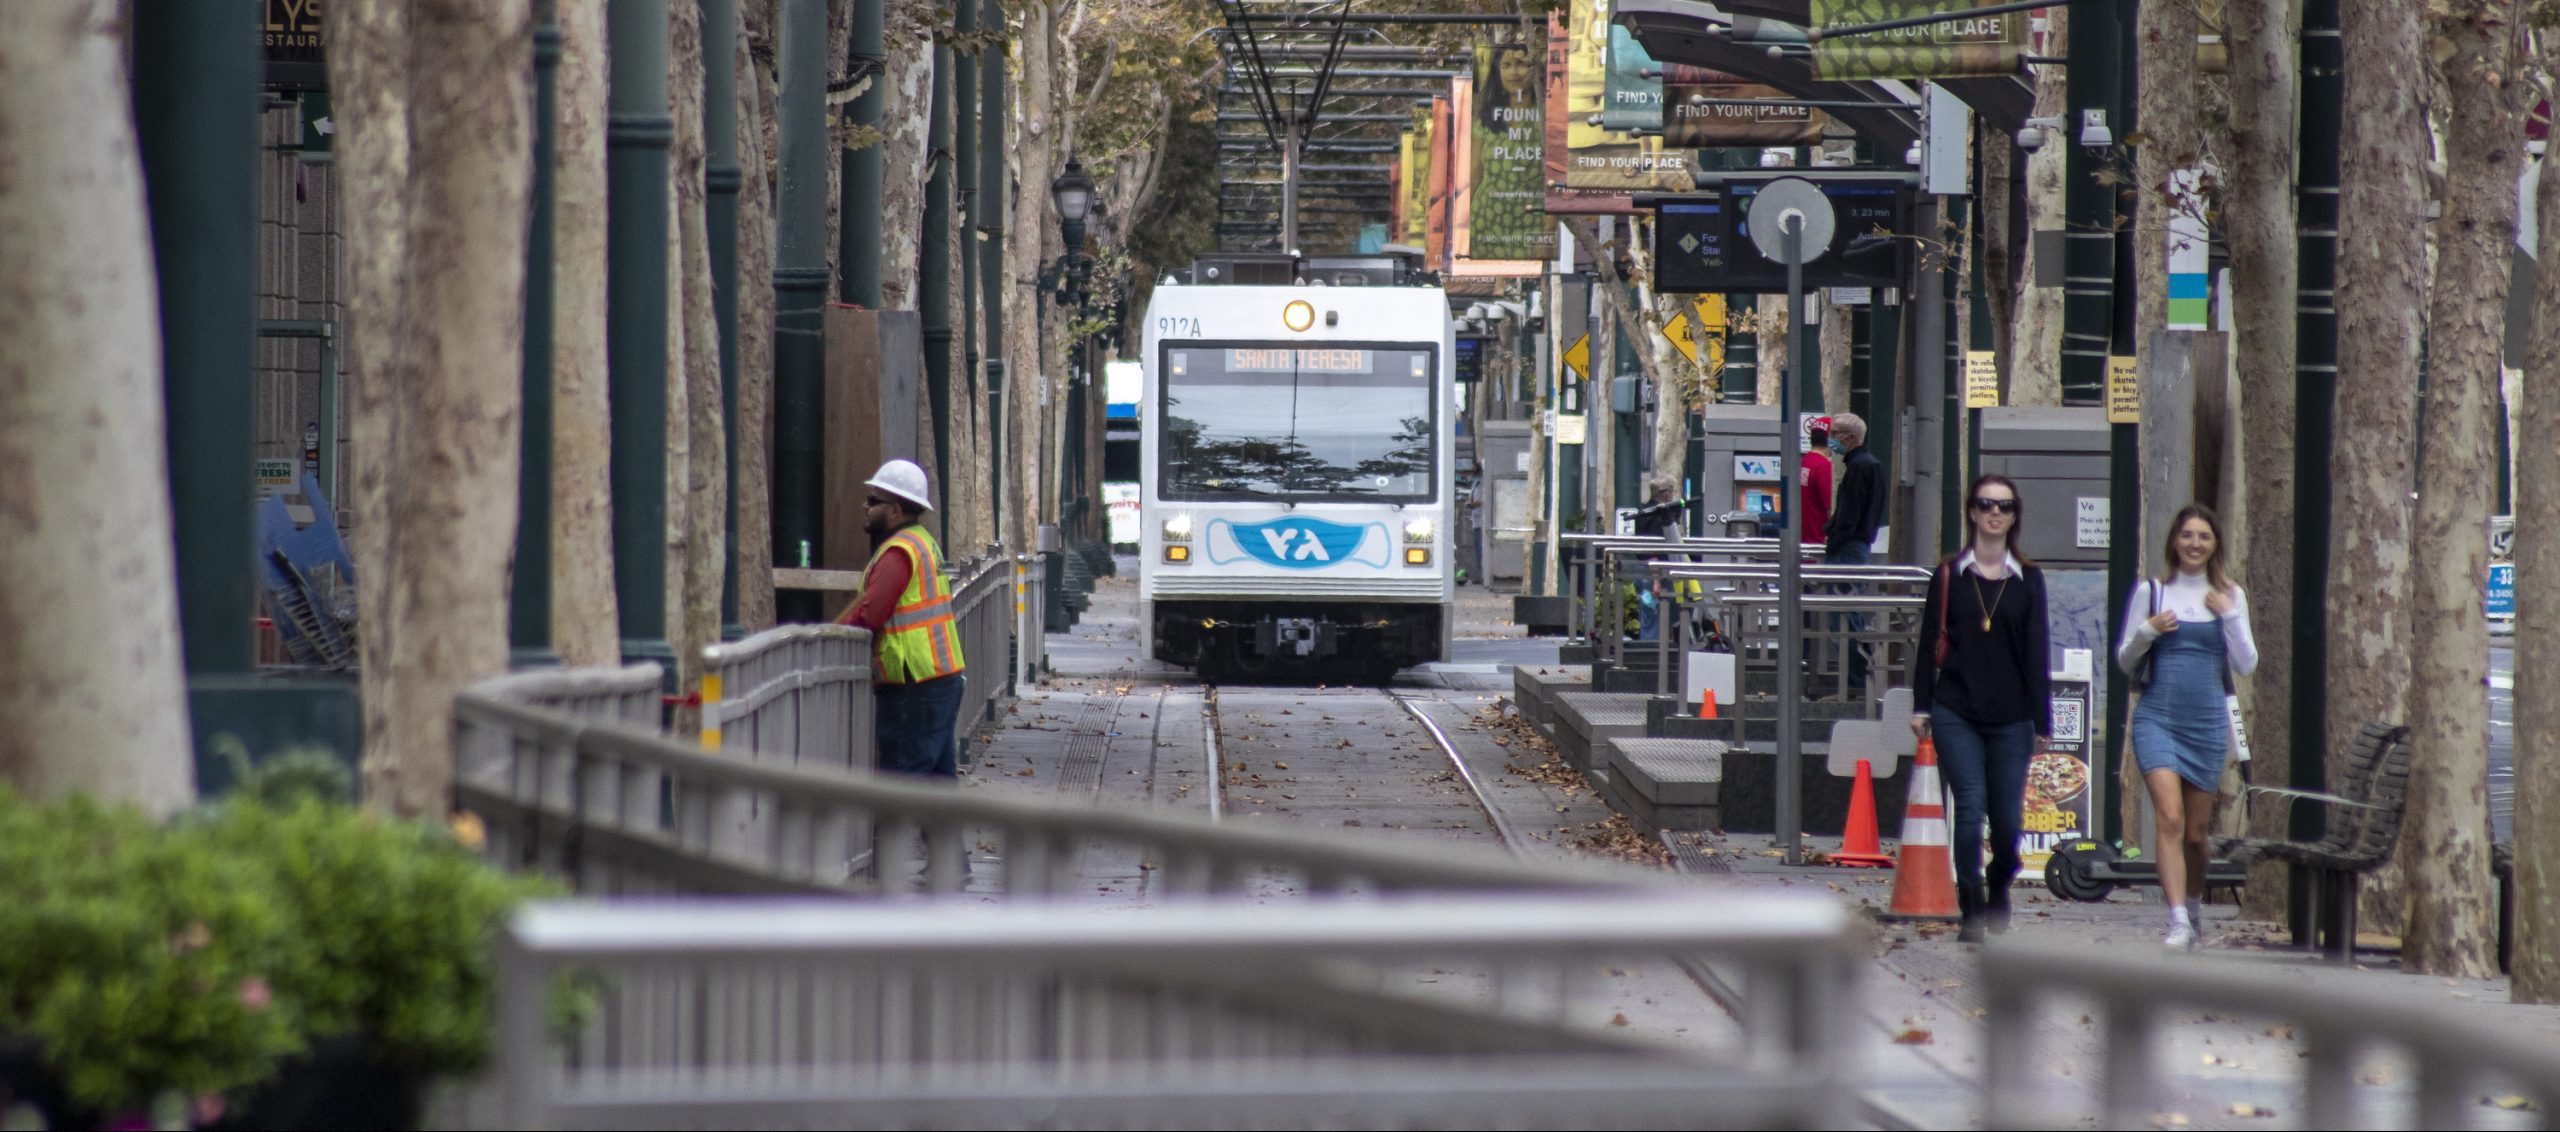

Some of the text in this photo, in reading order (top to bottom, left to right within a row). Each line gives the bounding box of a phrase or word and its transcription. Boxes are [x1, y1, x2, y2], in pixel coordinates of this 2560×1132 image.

[257, 0, 321, 32] LYS
[1940, 18, 2002, 36] PLACE
[1617, 91, 1663, 104] FIND Y
[1494, 108, 1540, 122] FOUN
[1676, 104, 1807, 117] FIND YOUR PLACE
[1508, 127, 1533, 141] MY
[1494, 146, 1543, 161] PLACE
[1578, 156, 1683, 169] FIND YOUR PLACE
[1875, 208, 1890, 217] min
[1526, 234, 1554, 244] PLACE
[1702, 257, 1721, 267] Yell
[1235, 349, 1363, 371] SANTA TERESA
[2114, 366, 2123, 374] No
[2232, 709, 2248, 748] BIRD
